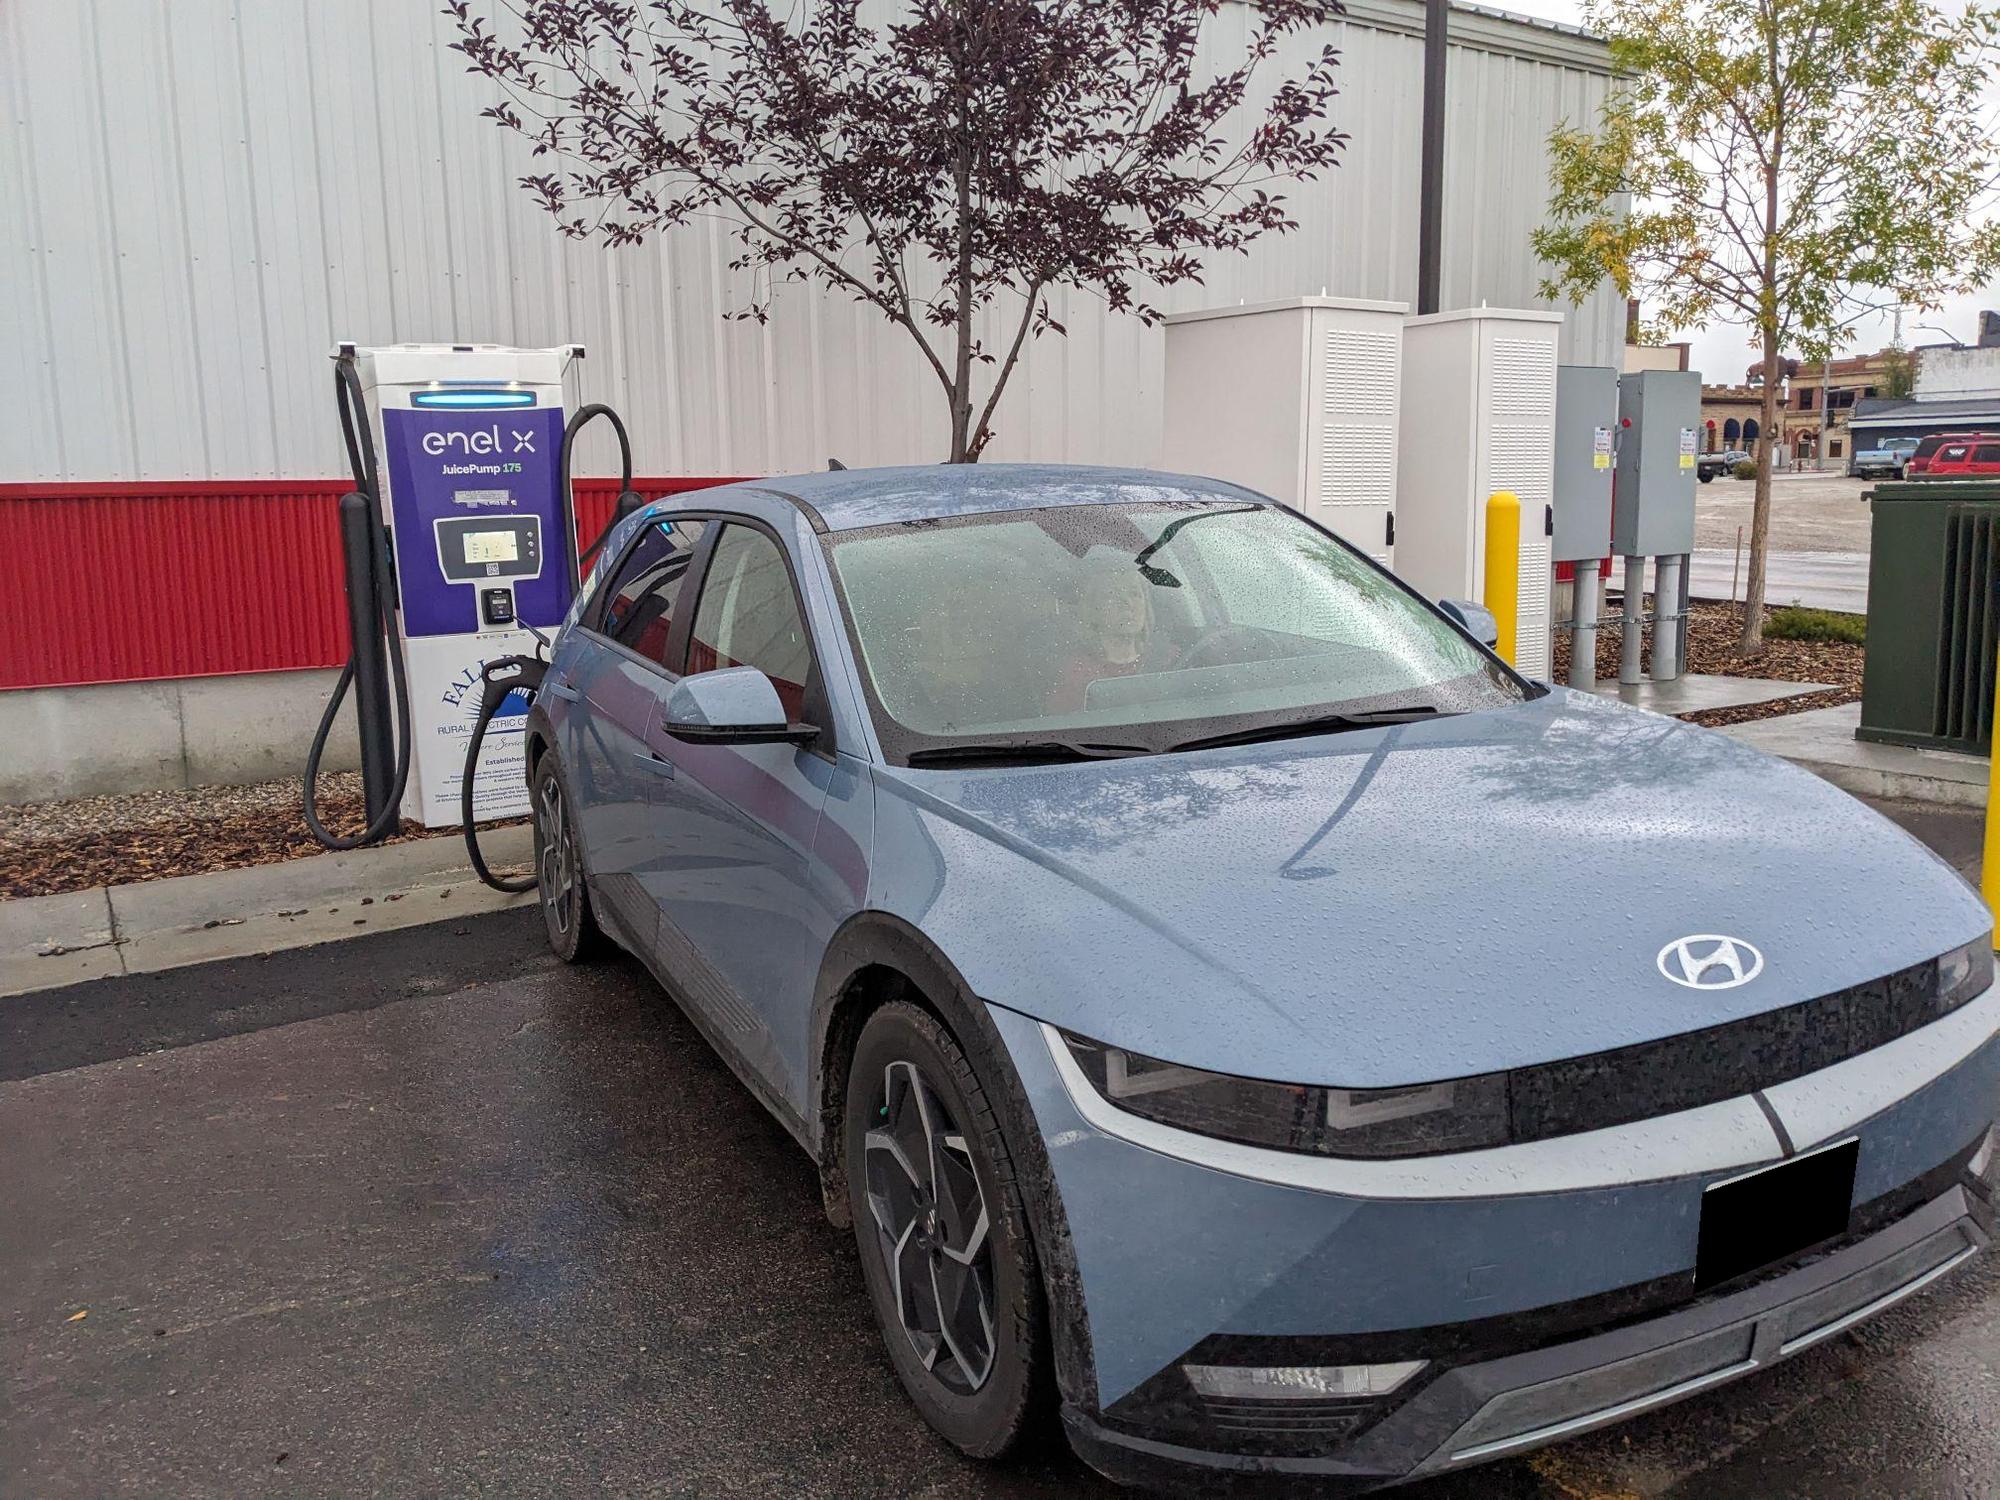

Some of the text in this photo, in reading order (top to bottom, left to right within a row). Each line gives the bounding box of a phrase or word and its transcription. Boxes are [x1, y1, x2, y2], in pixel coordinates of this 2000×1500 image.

[422, 424, 502, 455] enel
[442, 463, 522, 476] JuicePump 175
[437, 724, 470, 736] RURAL
[471, 718, 516, 732] ECTRIC
[485, 756, 525, 766] Established
